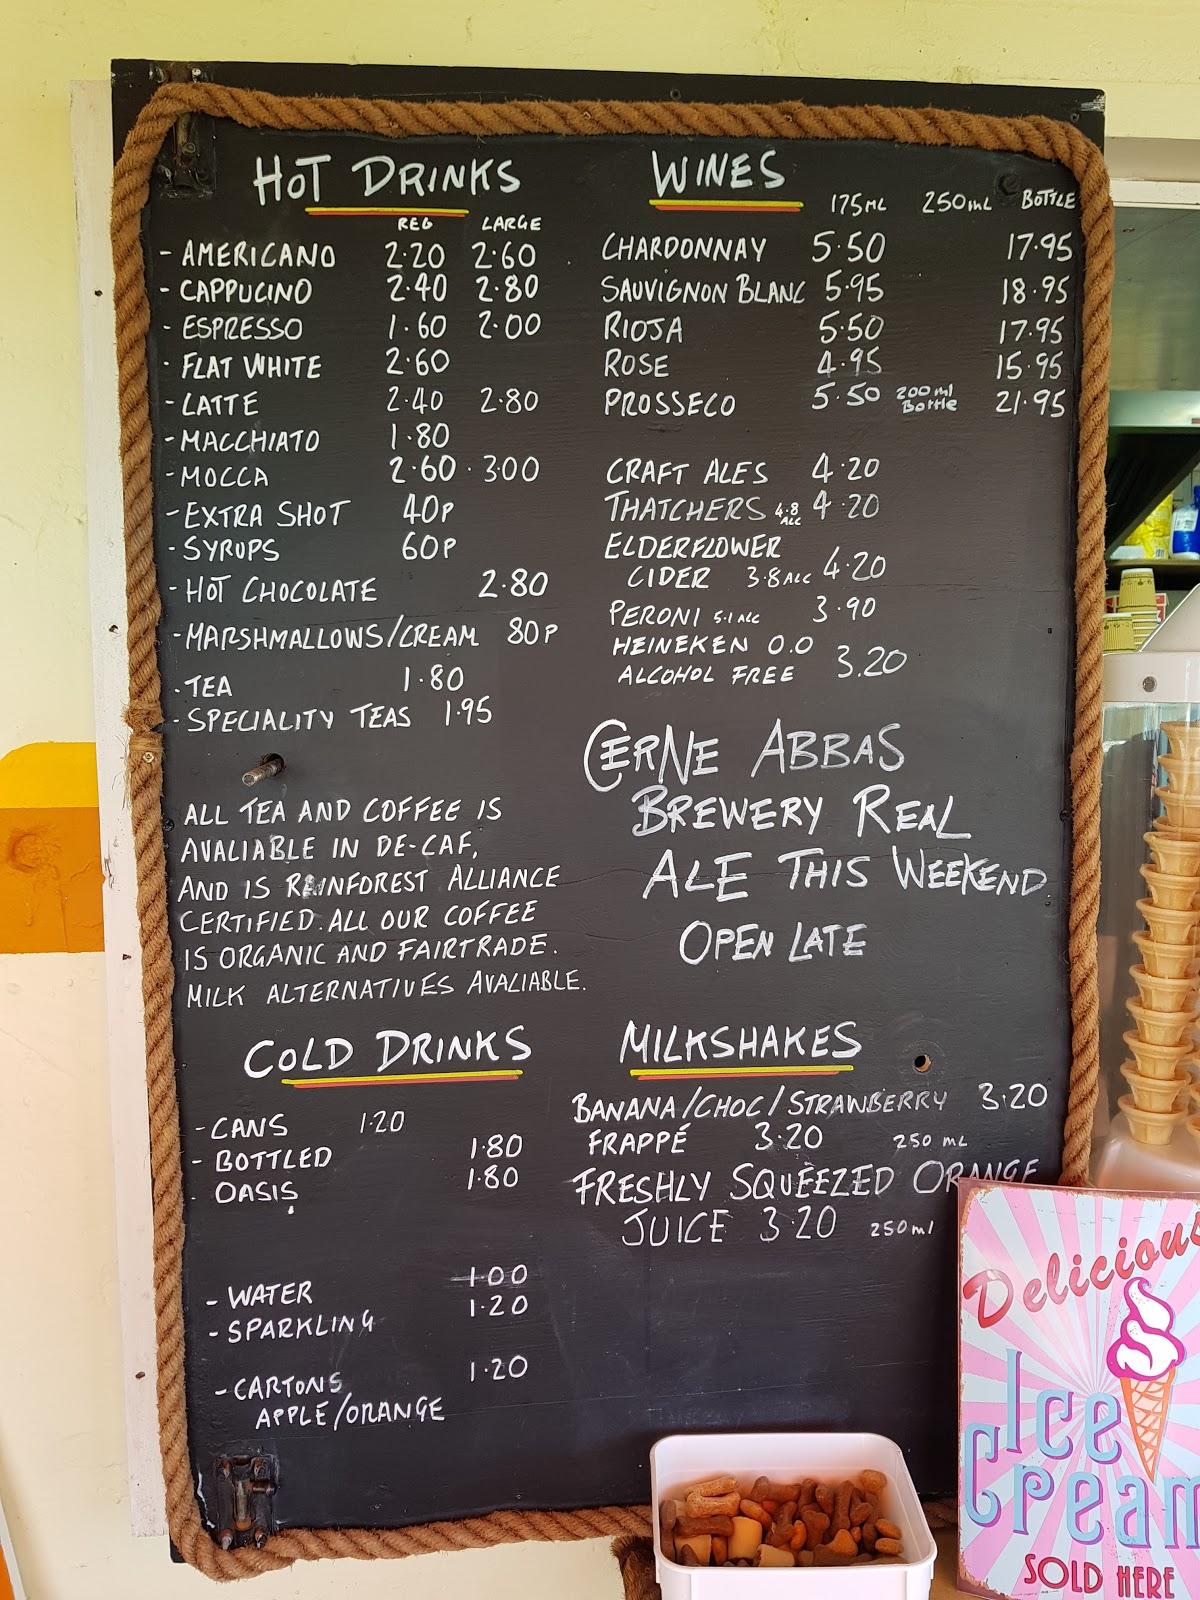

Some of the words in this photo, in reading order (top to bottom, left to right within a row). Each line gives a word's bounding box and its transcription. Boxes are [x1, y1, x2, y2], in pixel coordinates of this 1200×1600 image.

[253, 155, 331, 205] HOT
[352, 156, 520, 196] DRINKS
[652, 150, 784, 197] WINES
[1022, 189, 1074, 209] BOTTLE
[398, 217, 433, 230] REG
[482, 215, 541, 231] LARGE
[182, 240, 335, 267] AMERICANO
[602, 233, 766, 262] CHARDONNAY
[180, 278, 312, 304] CAPPUCINO
[601, 276, 727, 303] SAUVIGNON
[736, 274, 805, 303] BLANC
[183, 315, 302, 340] ESPRESSO
[605, 311, 682, 343] RIOJA
[182, 352, 232, 379] FLAT
[243, 353, 321, 378] WHITE
[605, 348, 668, 377] ROSE
[182, 391, 258, 415] LATTE
[605, 388, 735, 417] PROSSECO
[181, 430, 319, 452] MACCHIATO
[181, 467, 268, 487] MOCCA
[607, 458, 689, 484] CRAFT
[704, 458, 768, 484] ALES
[185, 502, 262, 528] EXTRA
[277, 500, 351, 526] SHOT
[605, 491, 766, 521] THATCHERS
[184, 536, 279, 561] SYRUPS
[605, 532, 781, 558] ELDERFLOWER
[187, 575, 231, 602] HOT
[243, 576, 377, 602] CHOCOLATE
[628, 566, 710, 588] CIDER
[610, 600, 700, 627] PERONI
[186, 615, 479, 651] MARSHMALLOWS/CREAM
[613, 635, 747, 655] HEINEKEN
[768, 635, 813, 654] 0.0
[838, 645, 907, 678] 3.20
[184, 675, 232, 697] TEA
[618, 665, 714, 685] ALCOHOL
[732, 666, 794, 685] FREE
[188, 708, 333, 732] SPECIALITY
[350, 703, 410, 728] TEAS
[584, 719, 718, 794] CERNE
[751, 718, 904, 777] ABBAS
[184, 804, 228, 825] ALL
[240, 797, 285, 824] TEA
[298, 799, 350, 822] AND
[363, 796, 461, 822] COFFEE
[477, 797, 501, 820] IS
[632, 781, 823, 836] BREWERY
[853, 784, 971, 839] REAL
[181, 835, 315, 862] AVALIABLE
[333, 838, 358, 858] IN
[377, 831, 477, 859] DE-CAF,
[178, 876, 228, 902] AND
[245, 876, 270, 899] IS
[448, 864, 560, 891] ALLIANCE
[643, 849, 752, 902] ALE
[778, 848, 870, 889] THIS
[328, 909, 368, 932] ALL
[381, 906, 429, 929] OUR
[444, 900, 537, 925] COFFEE
[186, 946, 207, 970] IS
[220, 944, 325, 969] ORGANIC
[337, 942, 386, 963] AND
[398, 934, 557, 961] FAIRTRADE.
[680, 921, 773, 965] OPEN
[789, 922, 867, 962] LATE
[188, 984, 245, 1008] MILK
[267, 973, 454, 1004] ALTERNATIVES
[467, 970, 585, 994] AVALIABLE.
[244, 1038, 353, 1078] COLD
[376, 1025, 531, 1072] DRINKS
[620, 1020, 862, 1063] MILKSHAKES
[211, 1114, 287, 1139] CANS
[216, 1147, 332, 1171] BOTTLED
[216, 1181, 298, 1203] OASIS
[571, 1168, 711, 1205] FRESHLY
[730, 1162, 894, 1200] SQUEEZED
[622, 1208, 729, 1246] JUICE
[228, 1281, 312, 1308] WATER
[229, 1310, 373, 1343] SPARKLING
[234, 1372, 342, 1400] CARTONS
[256, 1391, 444, 1430] APPLE/ORANGE
[1006, 1347, 1122, 1466] Ice
[1023, 1553, 1104, 1594] SOLD
[1116, 1565, 1175, 1599] HERE
